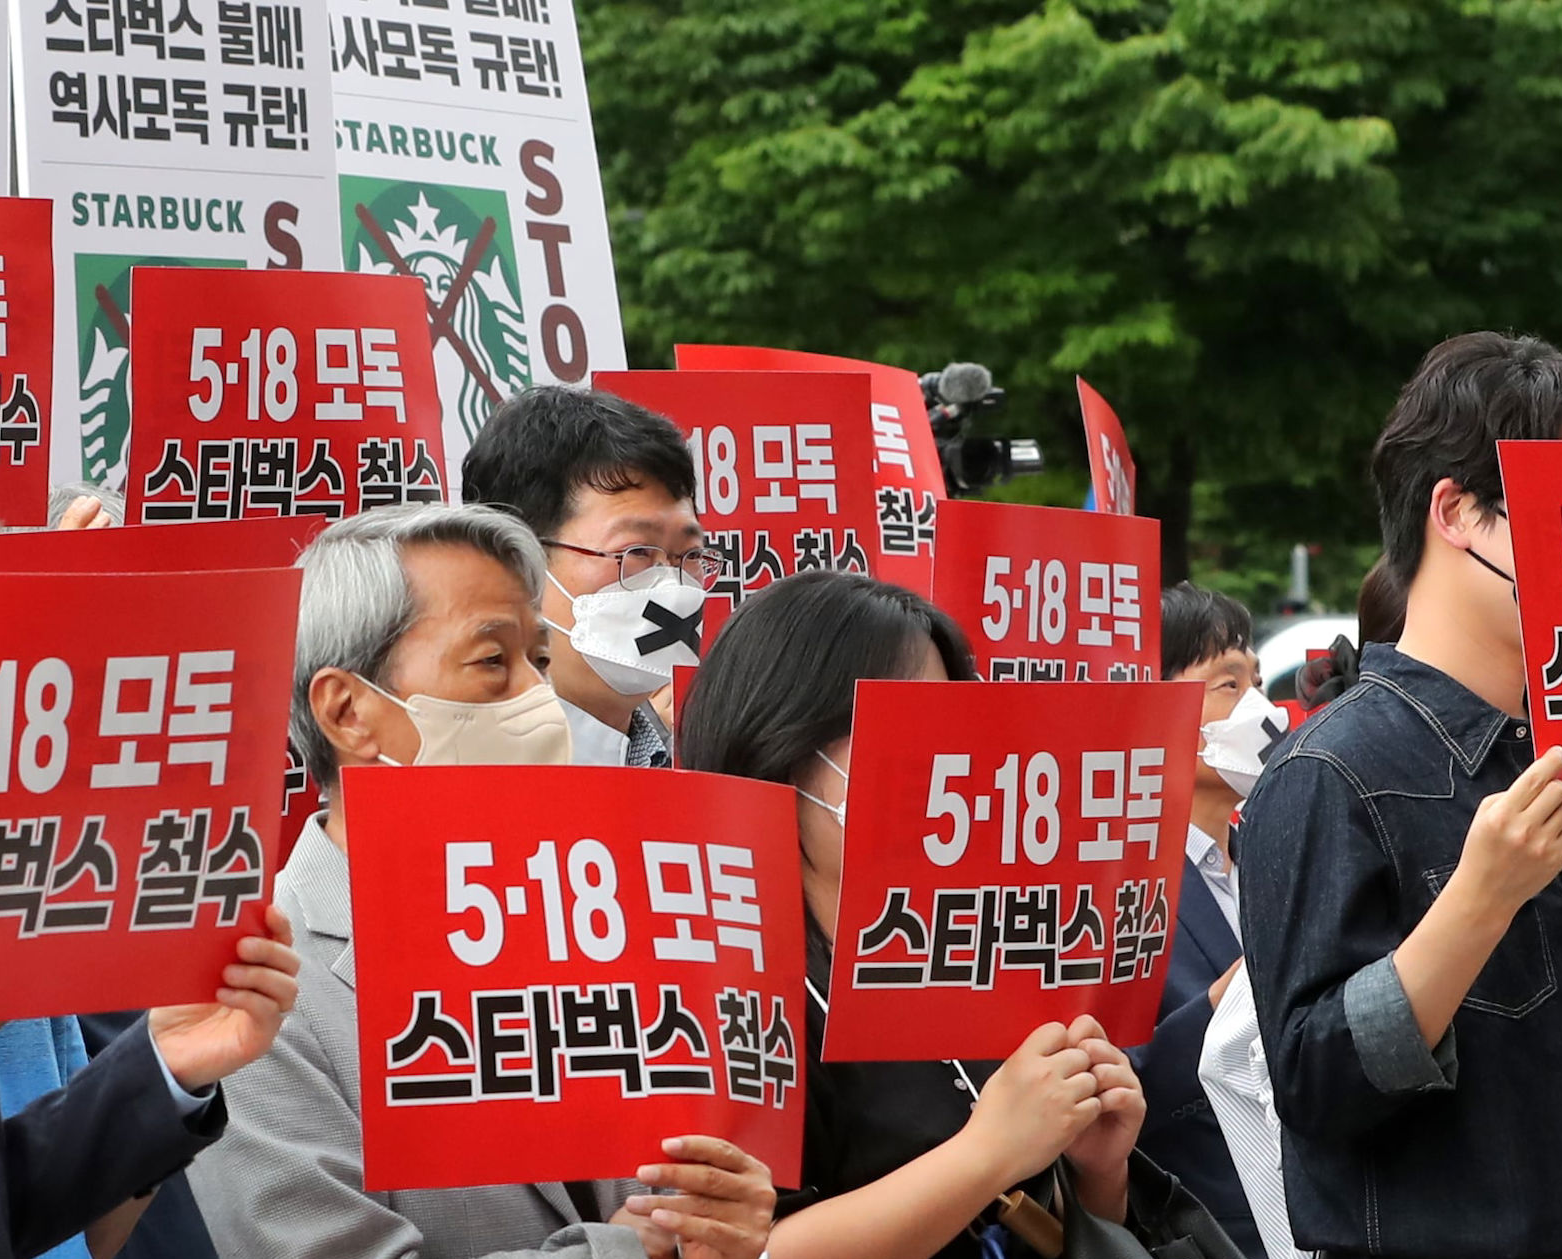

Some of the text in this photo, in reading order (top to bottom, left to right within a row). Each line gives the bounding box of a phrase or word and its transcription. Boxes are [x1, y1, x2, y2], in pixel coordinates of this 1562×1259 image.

[218, 0, 305, 70] 불매!
[468, 30, 563, 98] 규탄!
[49, 70, 309, 152] 역사모독 규탄!
[72, 191, 245, 233] STARBUCK
[315, 327, 407, 423] 모독
[140, 437, 347, 525] 스타벅스
[752, 423, 838, 515] 모독
[1077, 561, 1142, 652] 모독
[90, 649, 235, 789] 모독
[1077, 747, 1166, 862] 모독
[128, 805, 265, 933] 철수
[641, 839, 766, 974] 모독
[852, 877, 1169, 990] 스타벅스 철수
[385, 982, 798, 1110] 스타벅스 철수
